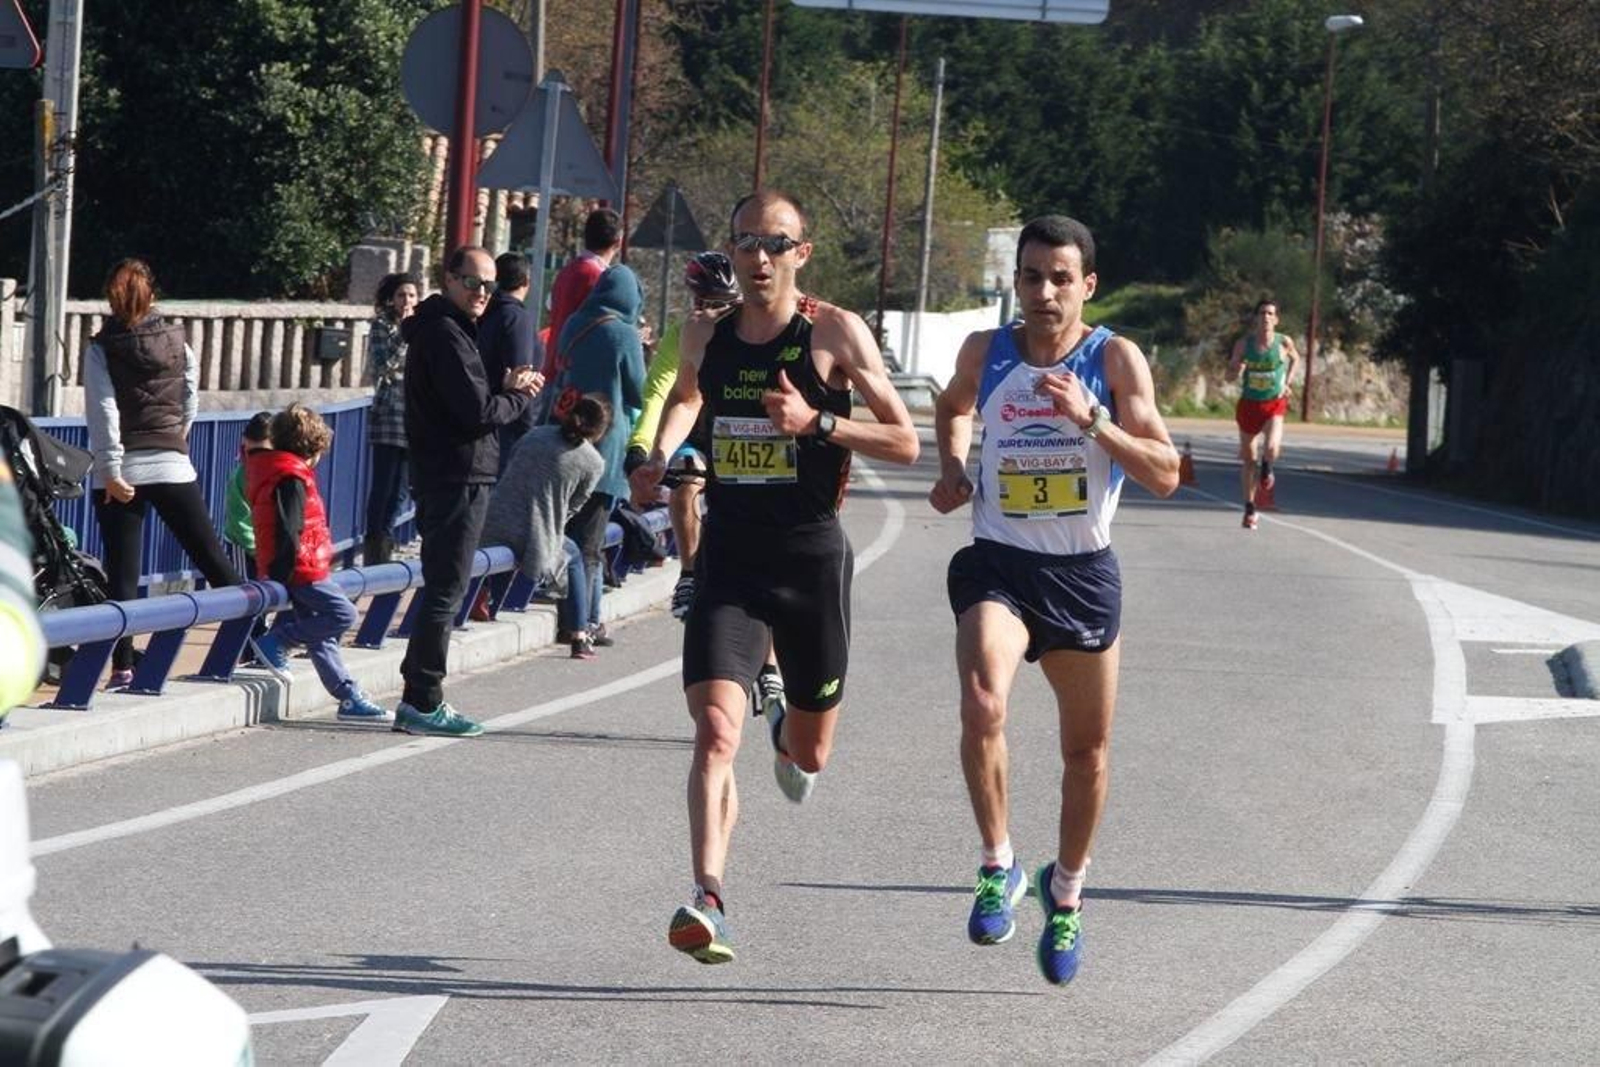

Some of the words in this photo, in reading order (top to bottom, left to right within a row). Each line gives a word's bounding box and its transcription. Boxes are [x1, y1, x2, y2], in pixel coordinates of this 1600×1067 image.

[739, 369, 768, 382] new
[726, 441, 775, 469] 4152
[1019, 456, 1067, 468] VIG-BAY
[1033, 477, 1048, 504] 3
